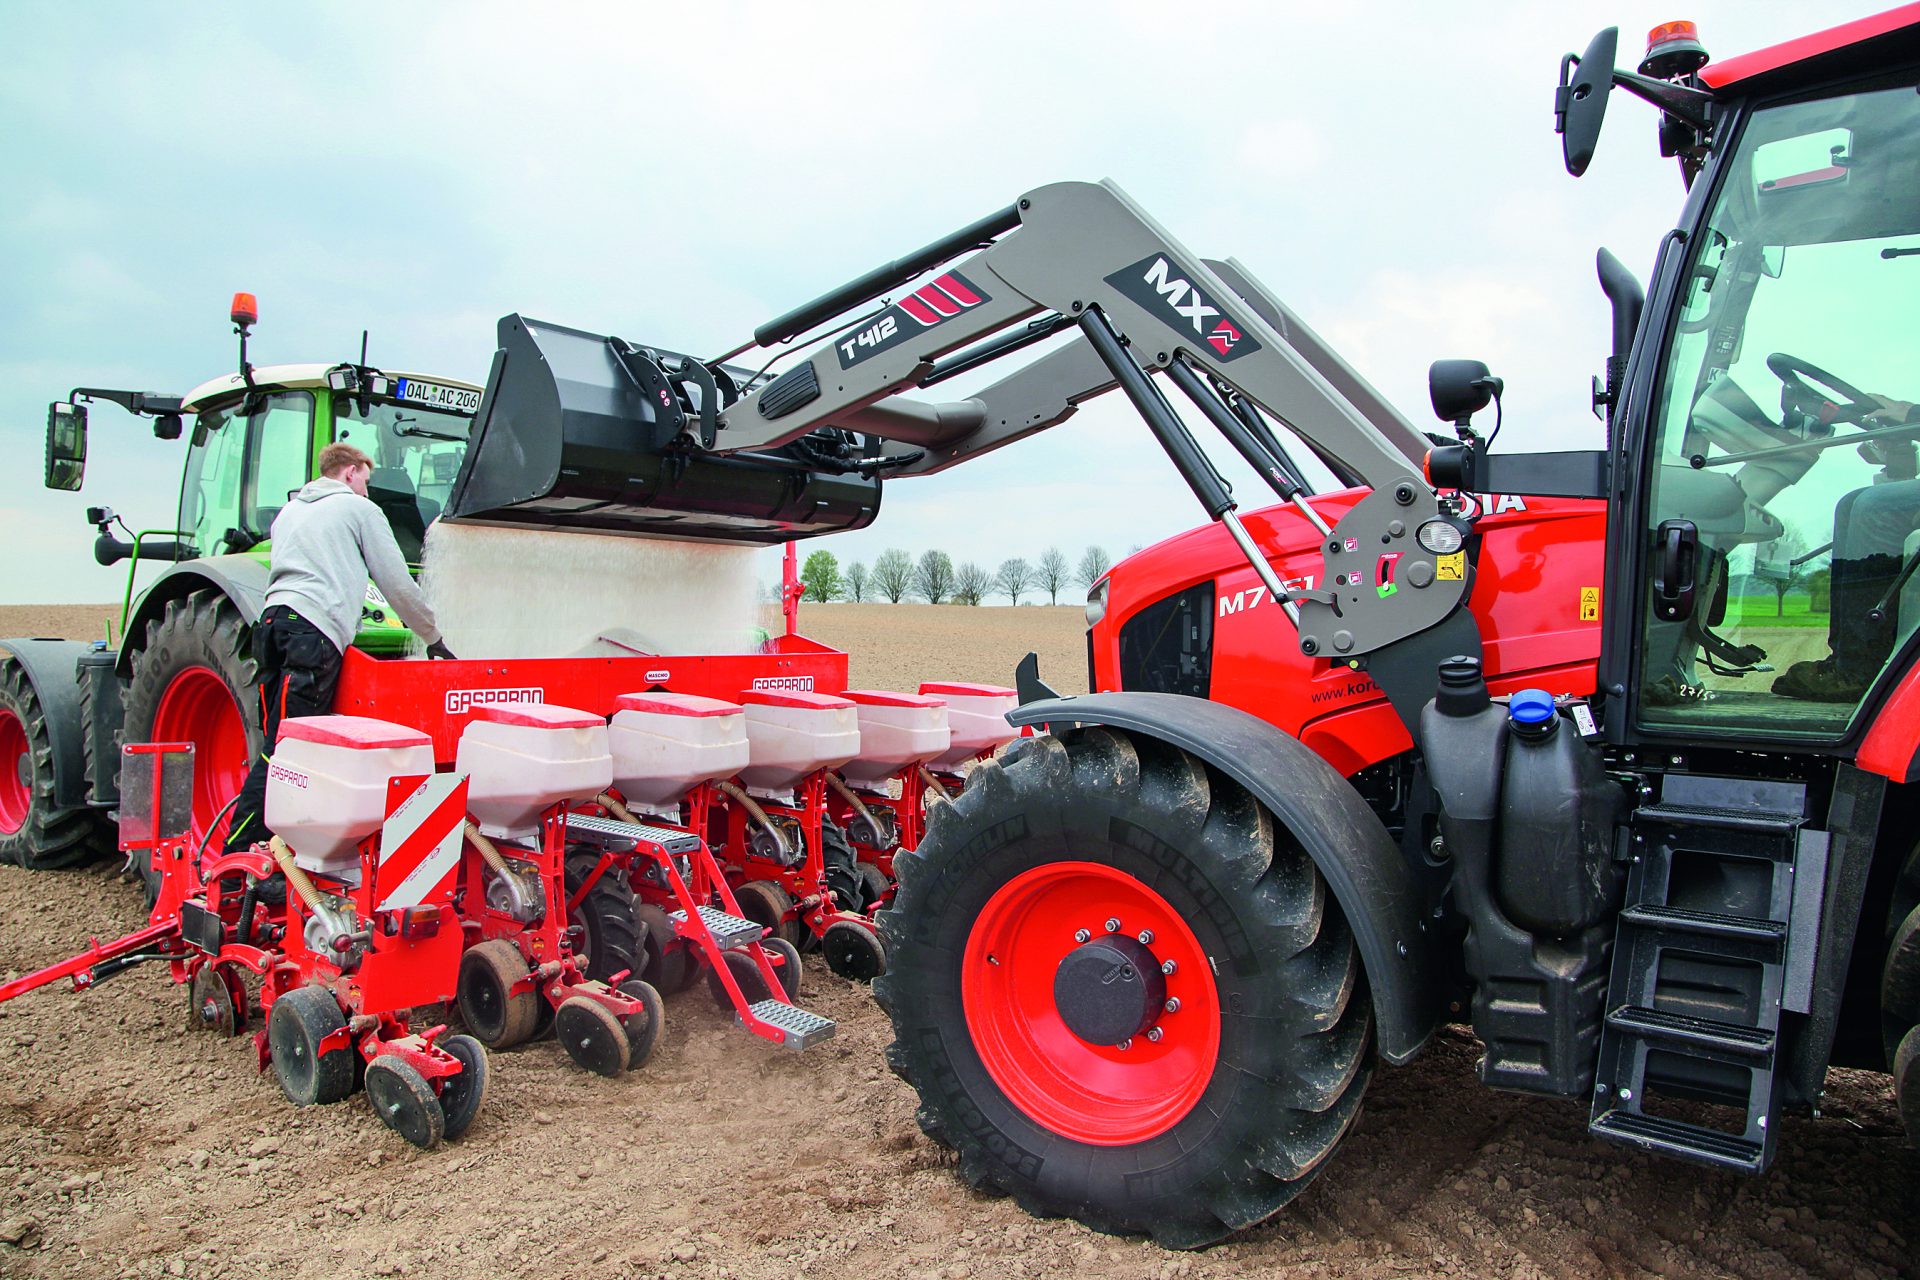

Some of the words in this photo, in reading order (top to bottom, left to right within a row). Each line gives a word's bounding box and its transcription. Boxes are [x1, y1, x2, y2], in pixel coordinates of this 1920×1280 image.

[1143, 257, 1220, 335] MX
[406, 383, 429, 400] OAL
[438, 388, 454, 404] AC
[455, 391, 477, 408] 206
[1437, 491, 1527, 520] OTA
[1219, 575, 1314, 617] M751
[753, 677, 813, 692] GASPARDO
[448, 689, 542, 711] GASPARDO
[271, 765, 308, 789] GASPARDO
[926, 813, 1027, 912] MICHELIN
